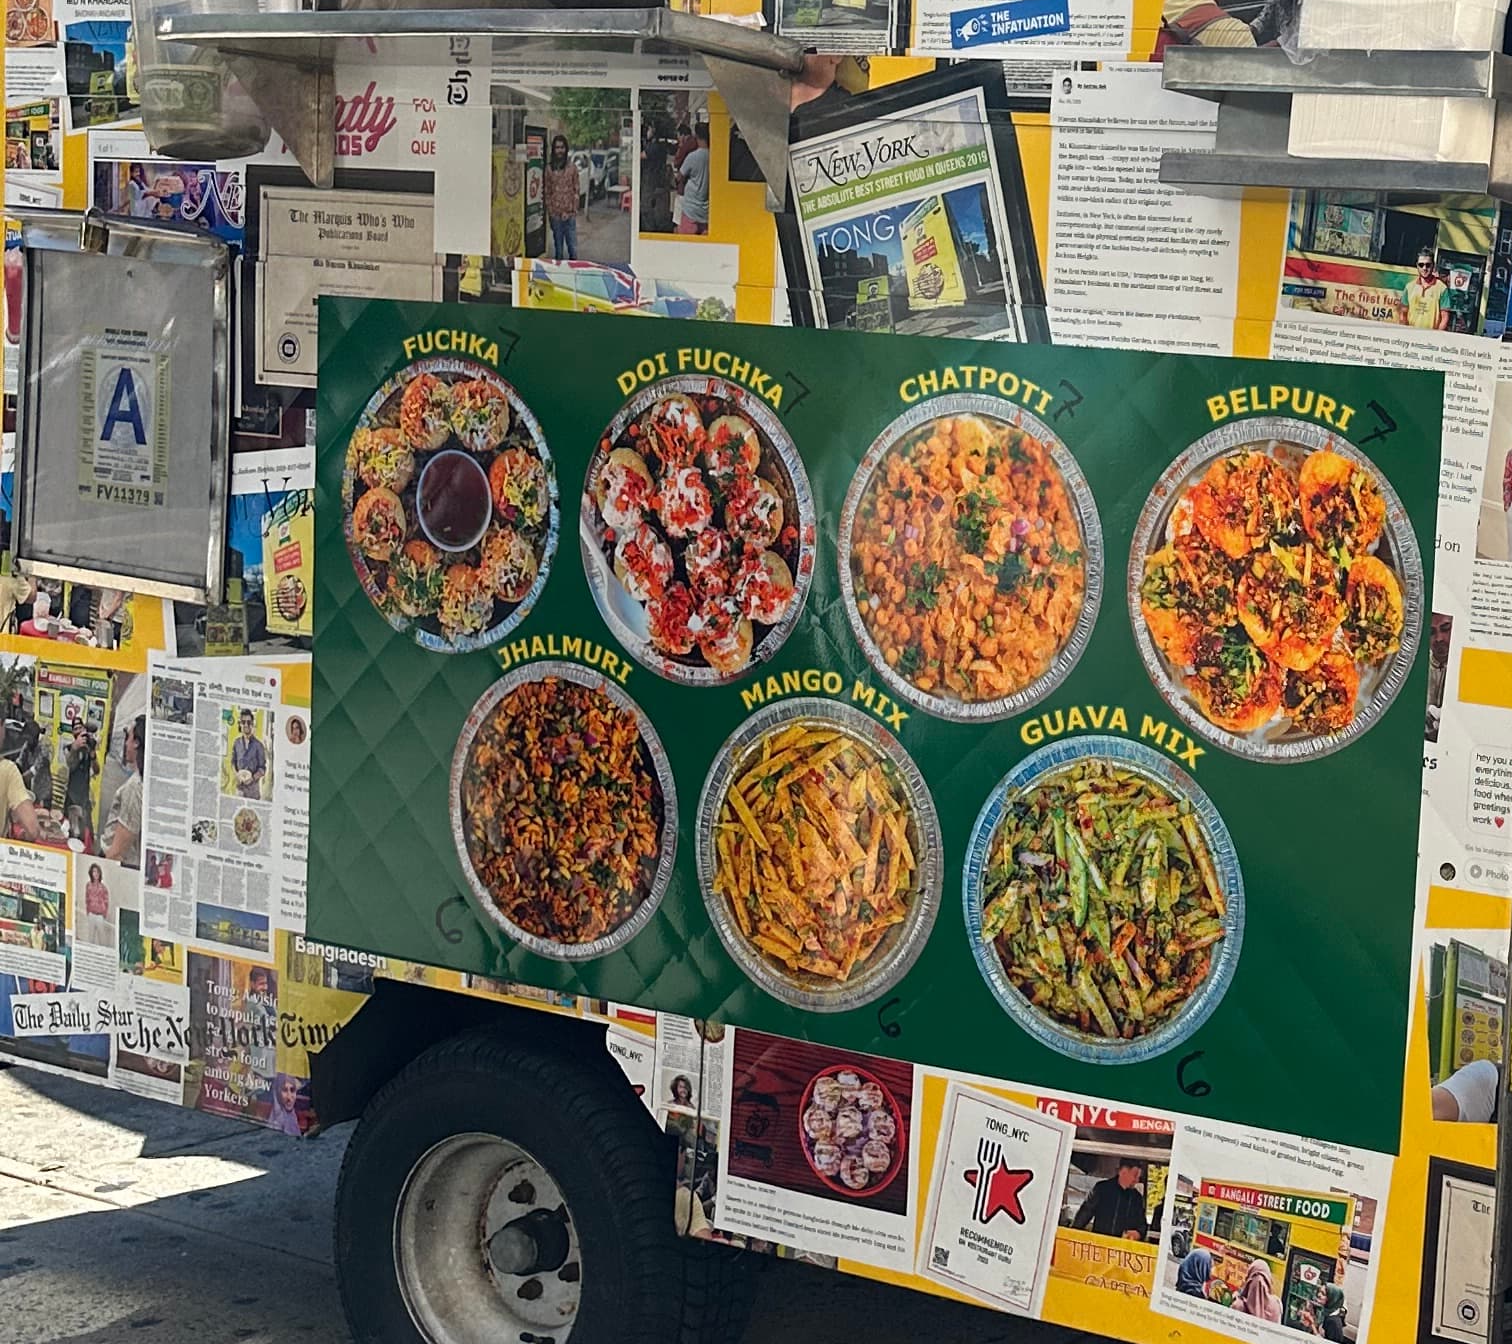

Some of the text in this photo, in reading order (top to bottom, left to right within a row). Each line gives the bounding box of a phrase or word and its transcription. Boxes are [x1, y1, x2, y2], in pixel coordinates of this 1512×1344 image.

[990, 11, 1010, 22] THE
[991, 13, 1065, 36] INFATUATION
[800, 134, 929, 193] NEW YORK
[802, 150, 987, 213] THE ABSOLUTE BEST STREET FOOD IN QUEENS 2019
[817, 215, 895, 258] TONG
[402, 329, 500, 368] FUCHKA
[615, 348, 785, 409] DOI FUCHKA
[899, 364, 1054, 416] CHATPOTI
[100, 367, 147, 446] A
[1206, 384, 1356, 432] BELPURI
[97, 485, 149, 502] FV11379
[498, 634, 634, 685] JHALMURI
[739, 668, 912, 734] MANGO MIX
[1020, 705, 1207, 771] GUAVA MIX
[14, 999, 134, 1034] The Daily Star
[876, 996, 902, 1040] 6
[203, 1083, 249, 1108] Yorkers
[1176, 1049, 1213, 1099] 6
[985, 1116, 1030, 1144] TONG_NYC
[1070, 1100, 1118, 1128] NYC
[1220, 1186, 1330, 1220] BANGALI STREET FOOD
[960, 1225, 1014, 1256] RECOMMENDED
